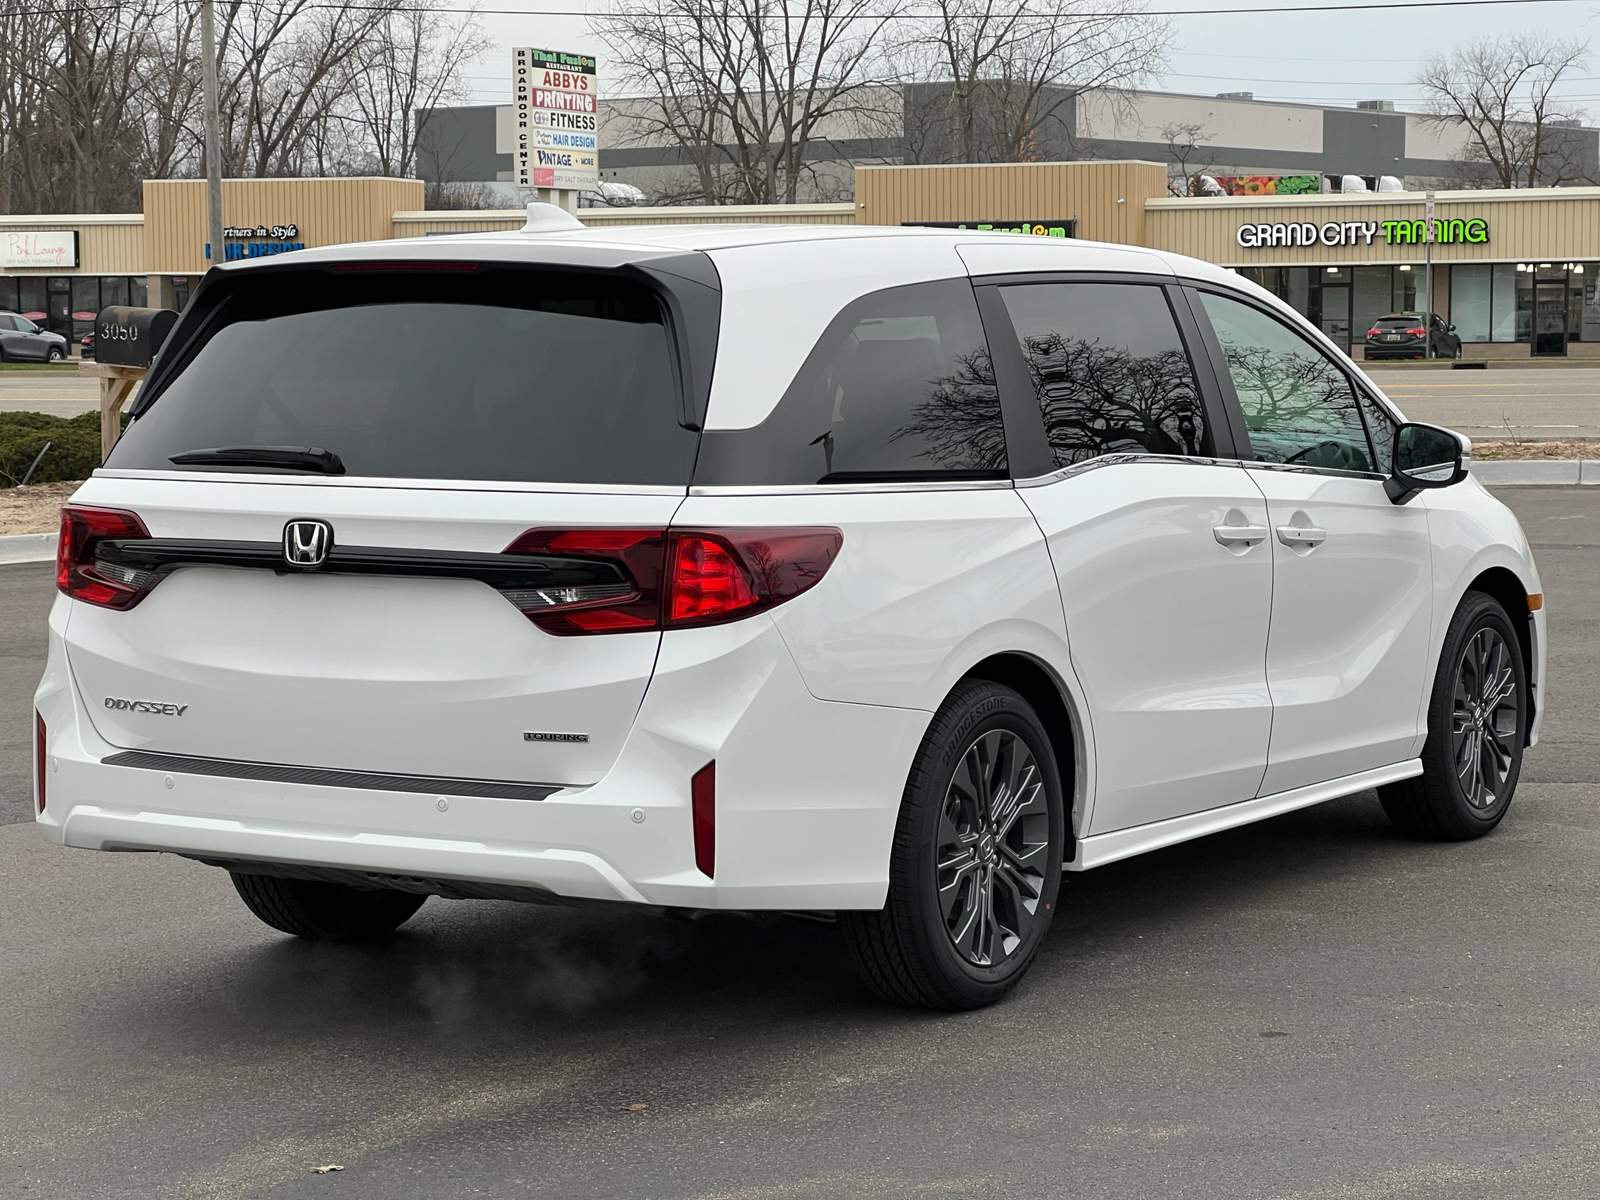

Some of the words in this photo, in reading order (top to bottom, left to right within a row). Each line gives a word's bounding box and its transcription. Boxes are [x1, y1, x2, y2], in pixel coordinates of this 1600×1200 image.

[533, 50, 557, 62] Thai
[560, 53, 595, 67] Fusion
[545, 62, 582, 72] RESTAURANT
[543, 71, 588, 90] ABBYS
[536, 91, 593, 111] PRINTING
[550, 112, 595, 130] FITNESS
[552, 134, 569, 146] HAIR
[570, 136, 595, 148] DESIGN
[519, 133, 529, 185] CENTER
[537, 150, 572, 166] VINTAGE
[223, 226, 252, 237] rtners
[256, 225, 267, 237] in
[270, 224, 297, 240] Style
[1236, 222, 1317, 248] GRAND
[1319, 221, 1377, 246] CITY
[1381, 218, 1488, 244] TANNING
[101, 322, 138, 341] 3050
[104, 696, 189, 717] ODYSSEY
[524, 732, 588, 742] TOURING
